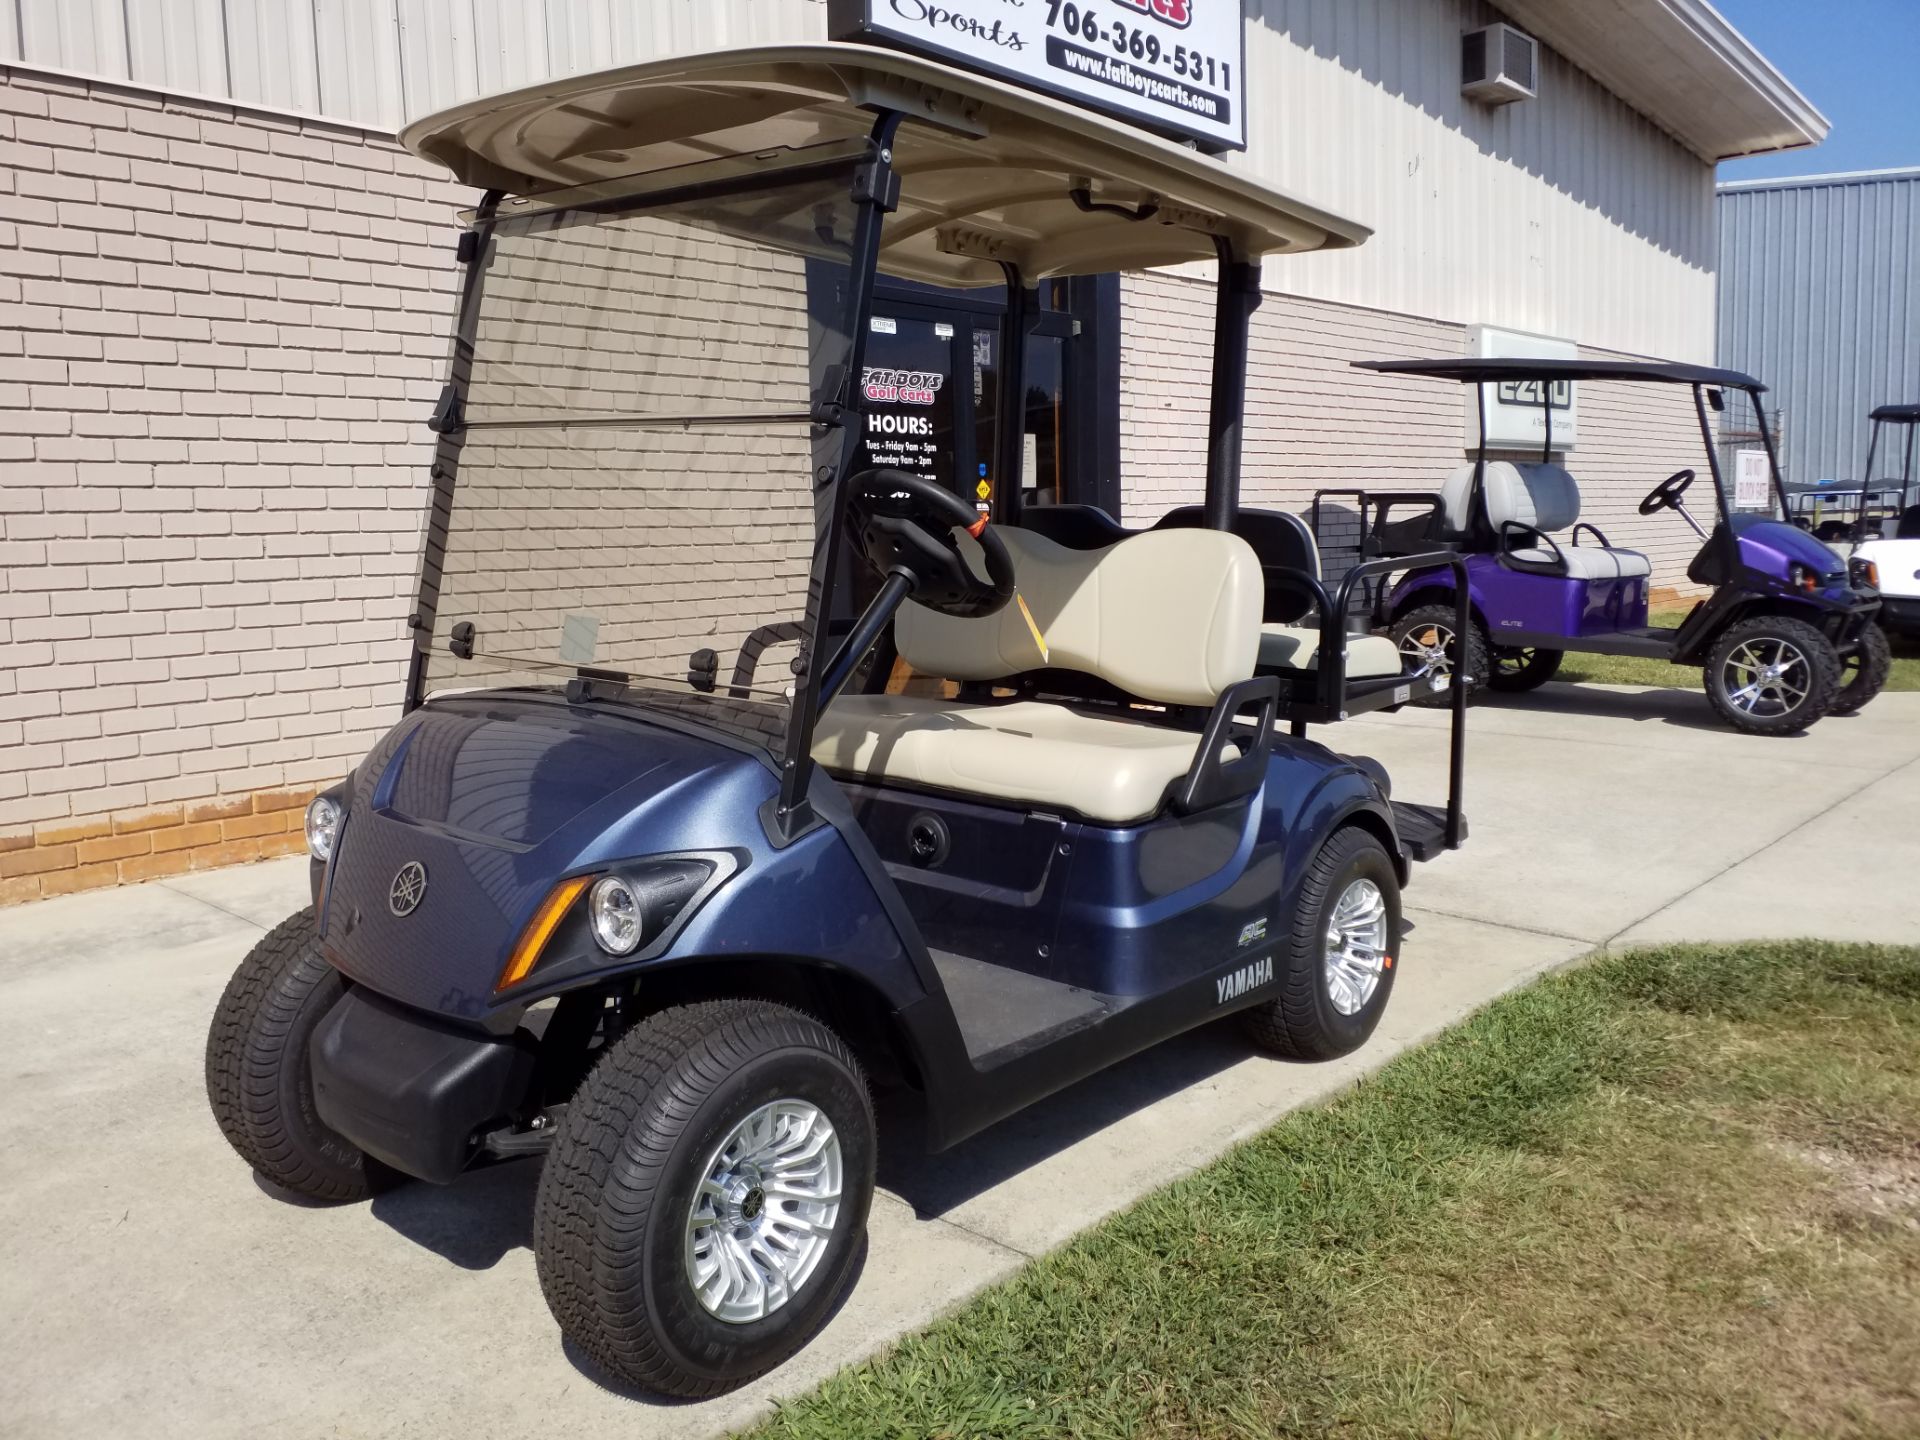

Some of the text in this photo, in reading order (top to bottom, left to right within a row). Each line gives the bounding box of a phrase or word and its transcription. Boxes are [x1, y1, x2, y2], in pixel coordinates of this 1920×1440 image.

[1046, 0, 1231, 92] 706-369-5311
[1064, 49, 1217, 116] www.fatboyscarts.com
[896, 371, 942, 390] BOYS
[867, 386, 933, 402] Golf Carts
[868, 414, 933, 435] HOURS:
[866, 440, 880, 449] Tues
[885, 441, 904, 453] Friday
[905, 442, 918, 451] 9am
[924, 443, 937, 454] 5pm
[872, 454, 899, 466] Saturday
[900, 455, 914, 464] 9am
[919, 456, 932, 467] 2pm
[1216, 956, 1273, 1004] YAMAHA
